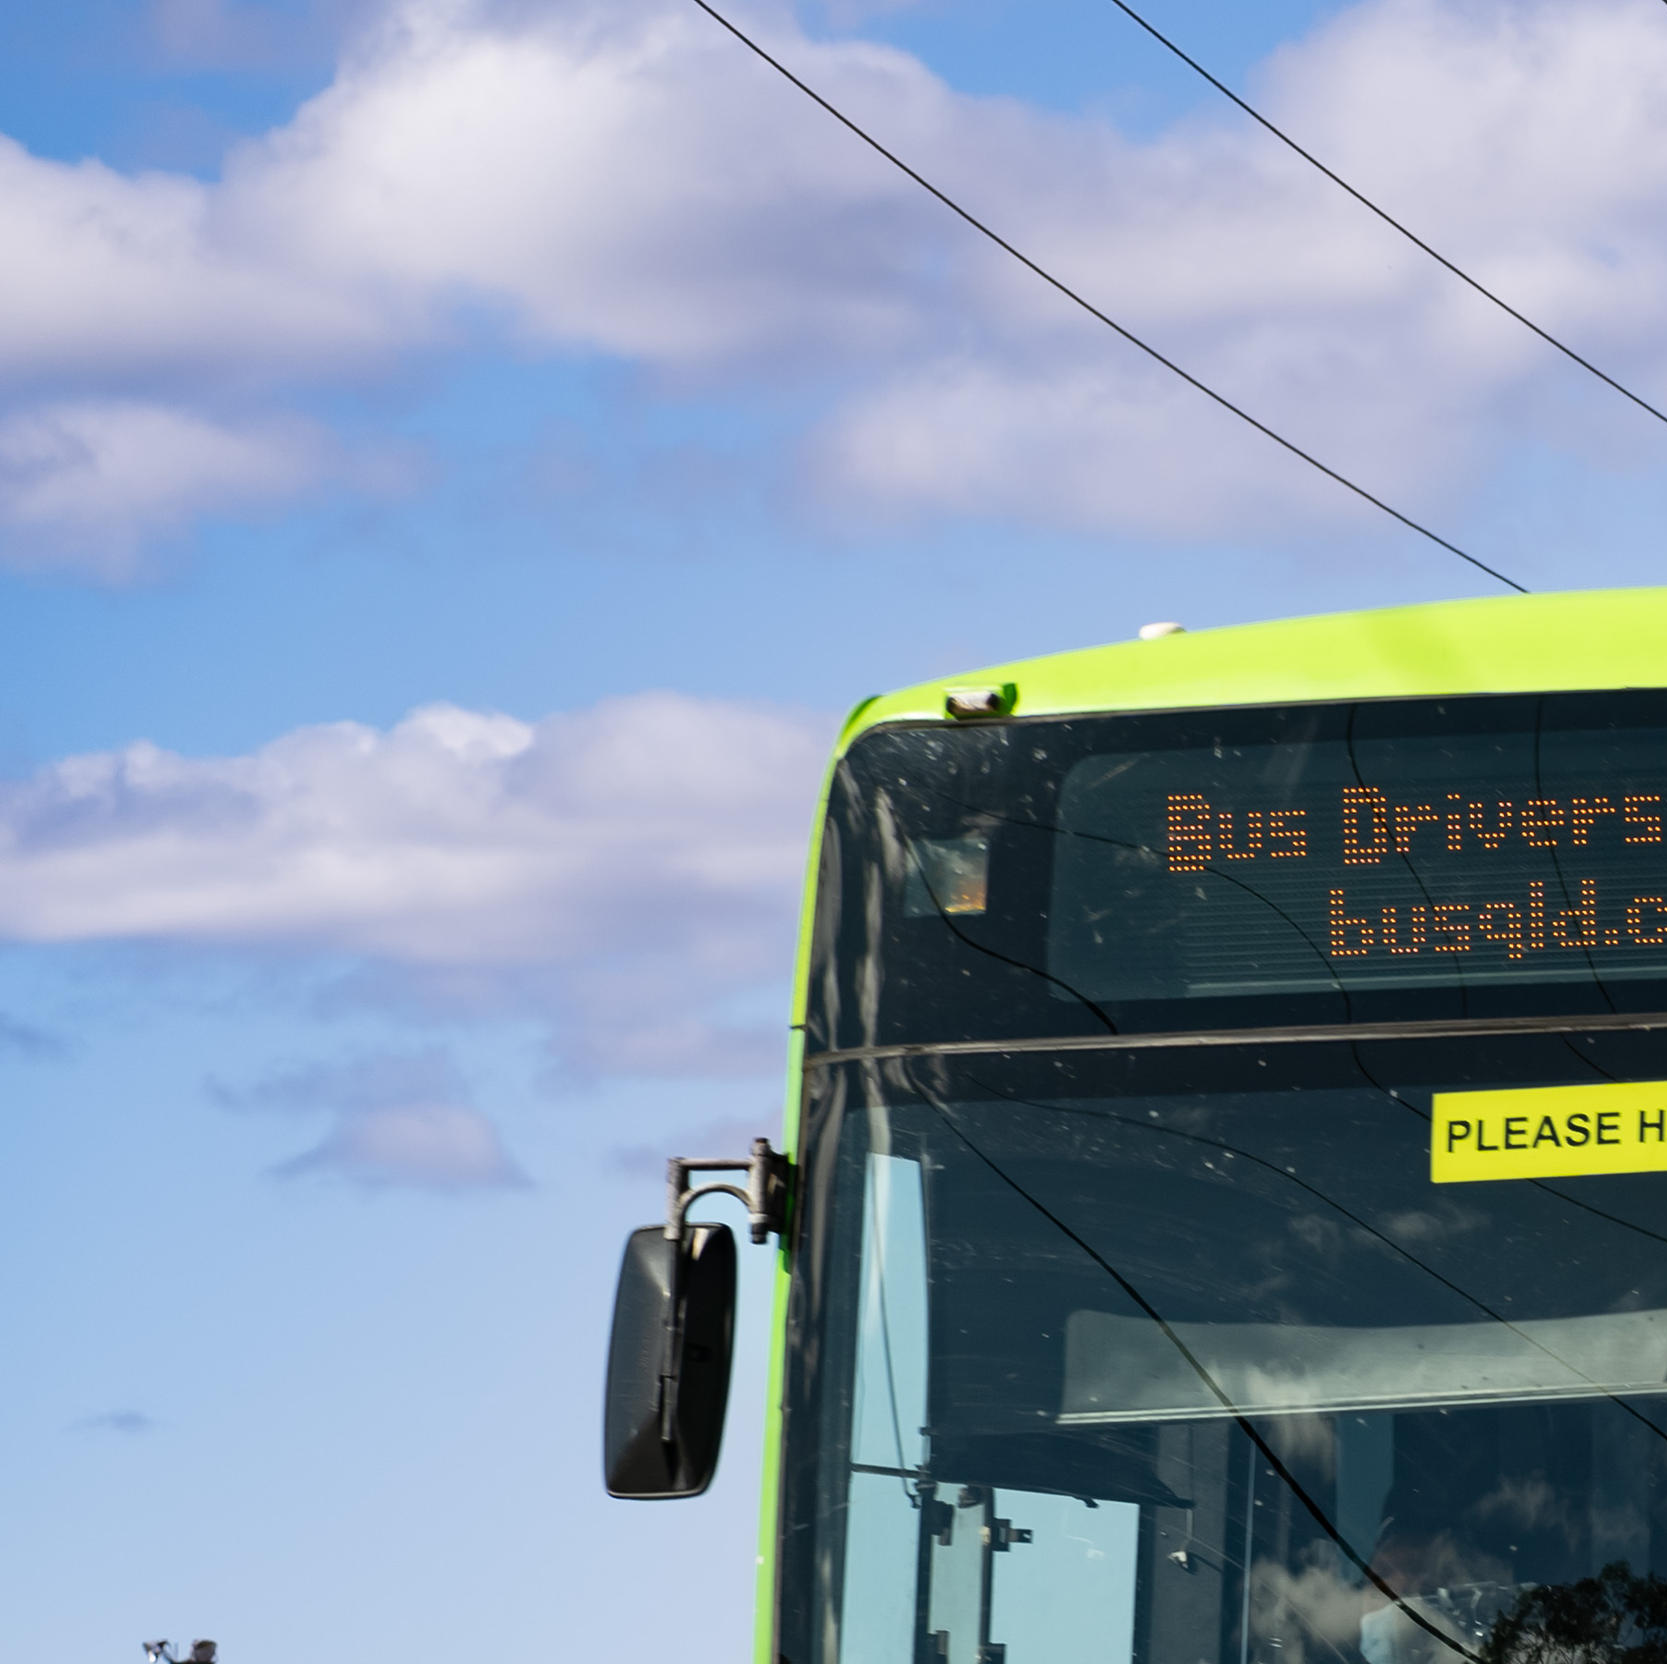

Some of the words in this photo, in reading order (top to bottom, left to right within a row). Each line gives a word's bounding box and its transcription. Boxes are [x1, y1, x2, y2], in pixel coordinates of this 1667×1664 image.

[1168, 794, 1307, 872] Bus
[1342, 787, 1662, 866] Drivers
[1447, 1112, 1620, 1153] PLEASE
